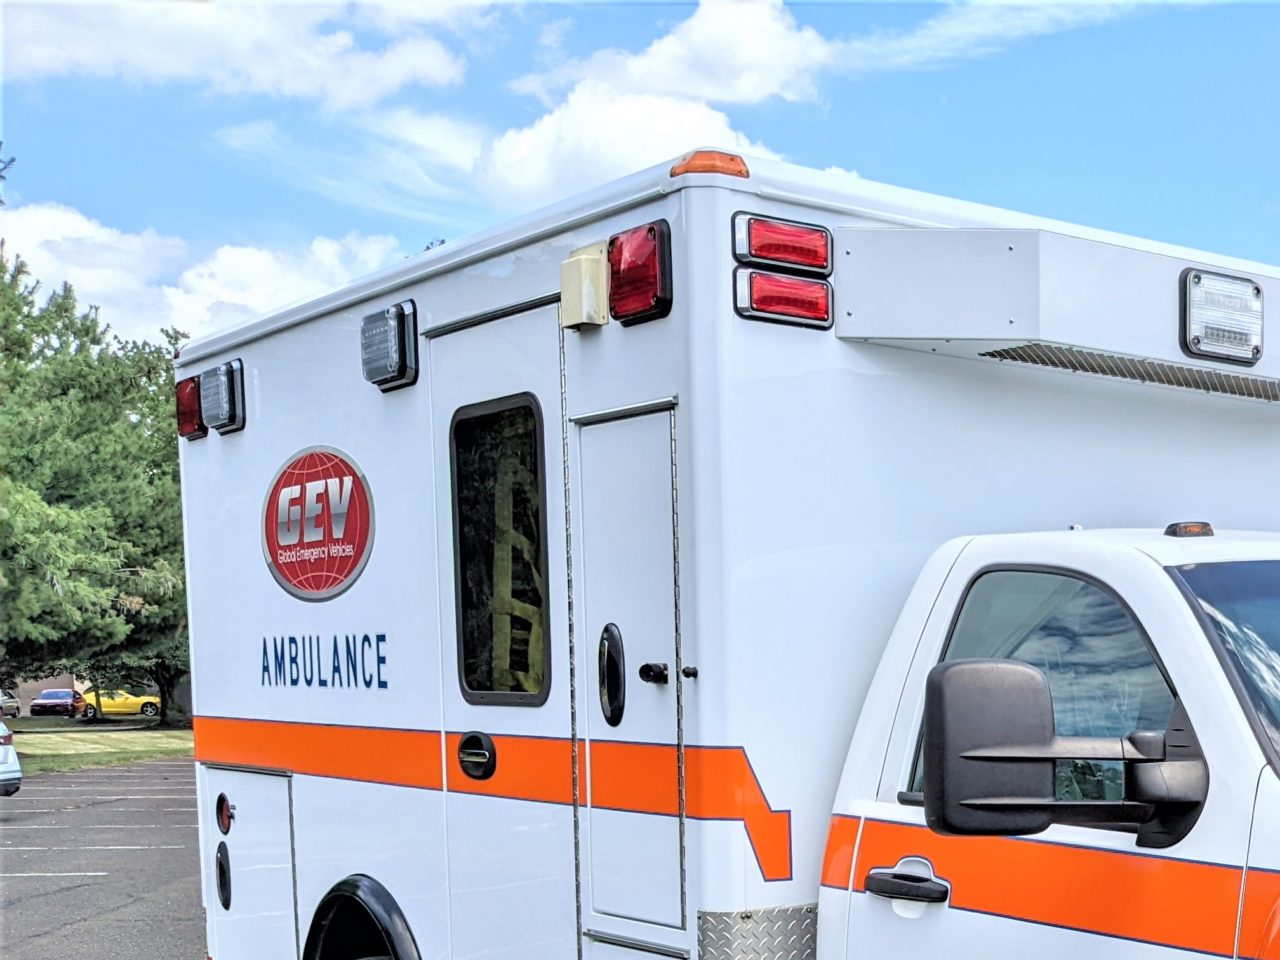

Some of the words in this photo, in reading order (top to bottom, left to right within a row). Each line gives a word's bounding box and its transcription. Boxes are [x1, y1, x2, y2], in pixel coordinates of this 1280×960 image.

[277, 475, 353, 547] GEV
[278, 547, 297, 564] Global
[296, 546, 328, 563] Emergency
[328, 542, 354, 559] Vehicles
[261, 634, 388, 689] AMBULANCE
